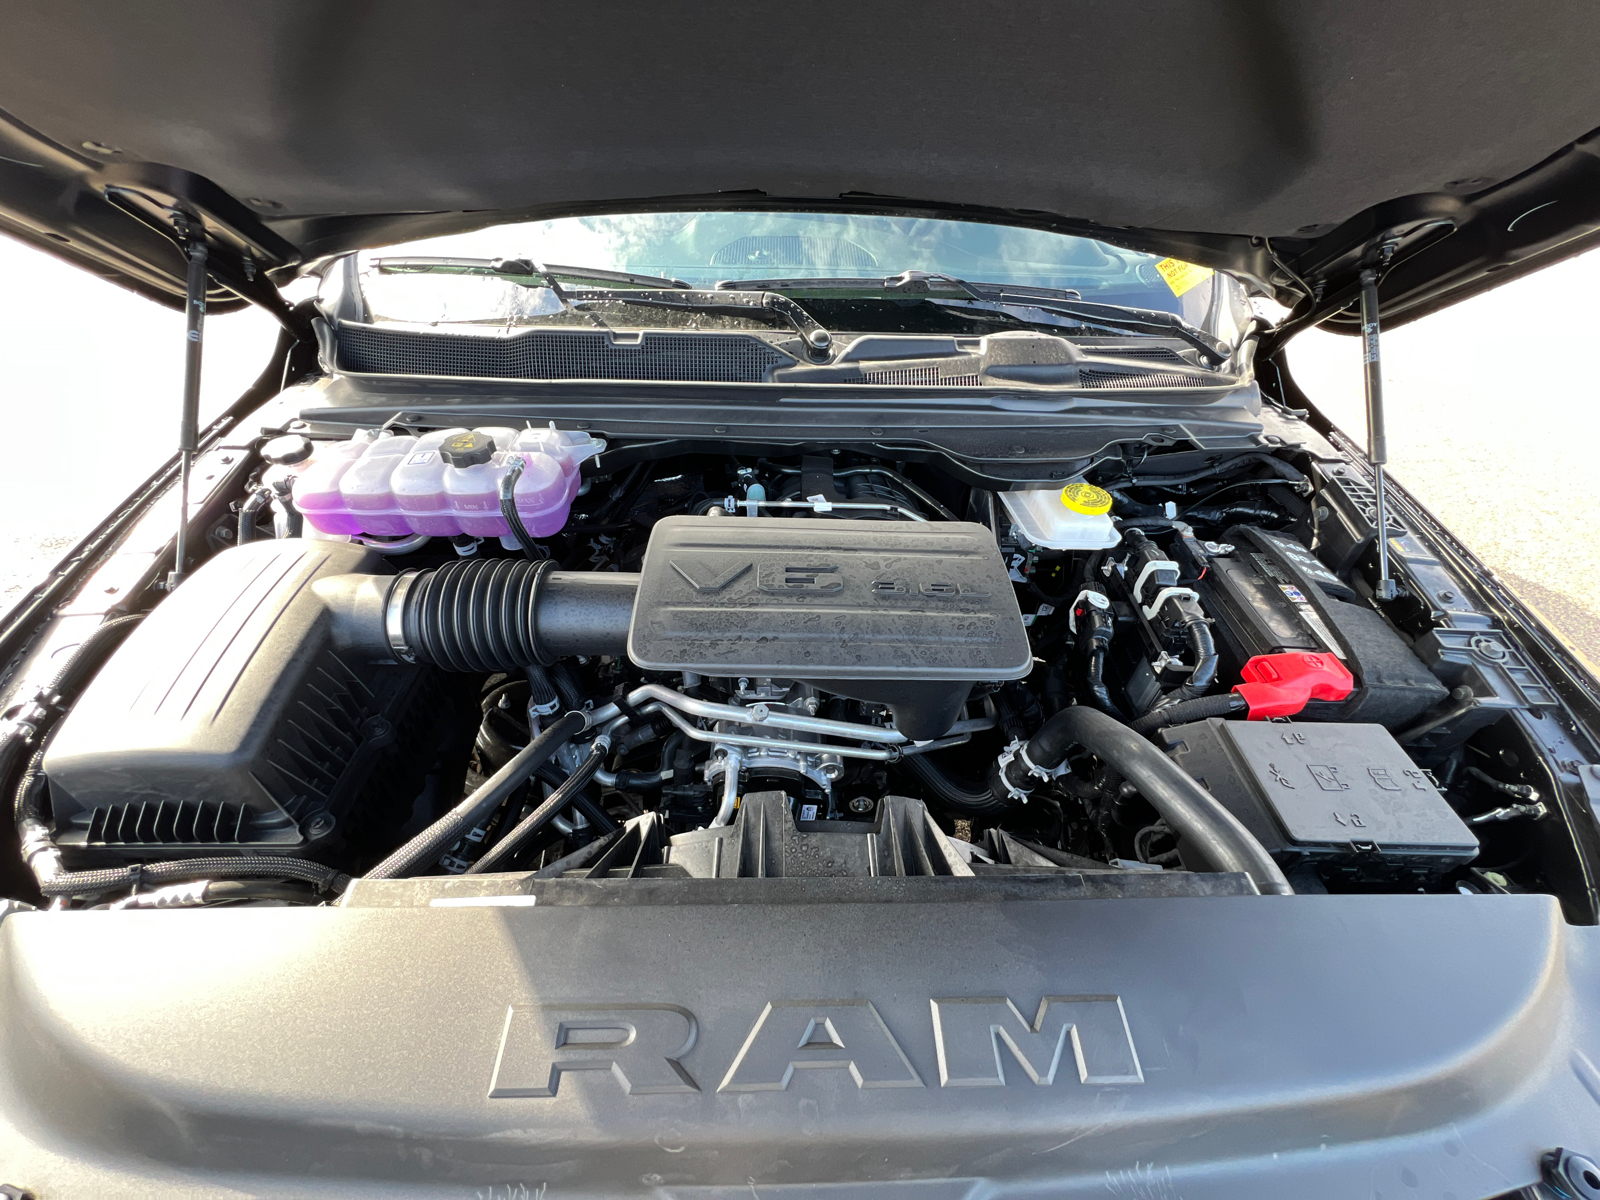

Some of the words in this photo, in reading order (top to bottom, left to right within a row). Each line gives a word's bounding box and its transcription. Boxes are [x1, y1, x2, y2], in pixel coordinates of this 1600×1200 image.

[1159, 259, 1175, 272] THIS
[1166, 268, 1178, 278] NOT
[669, 559, 845, 595] V6
[870, 580, 993, 598] 3.6L
[487, 995, 1145, 1099] RAM
